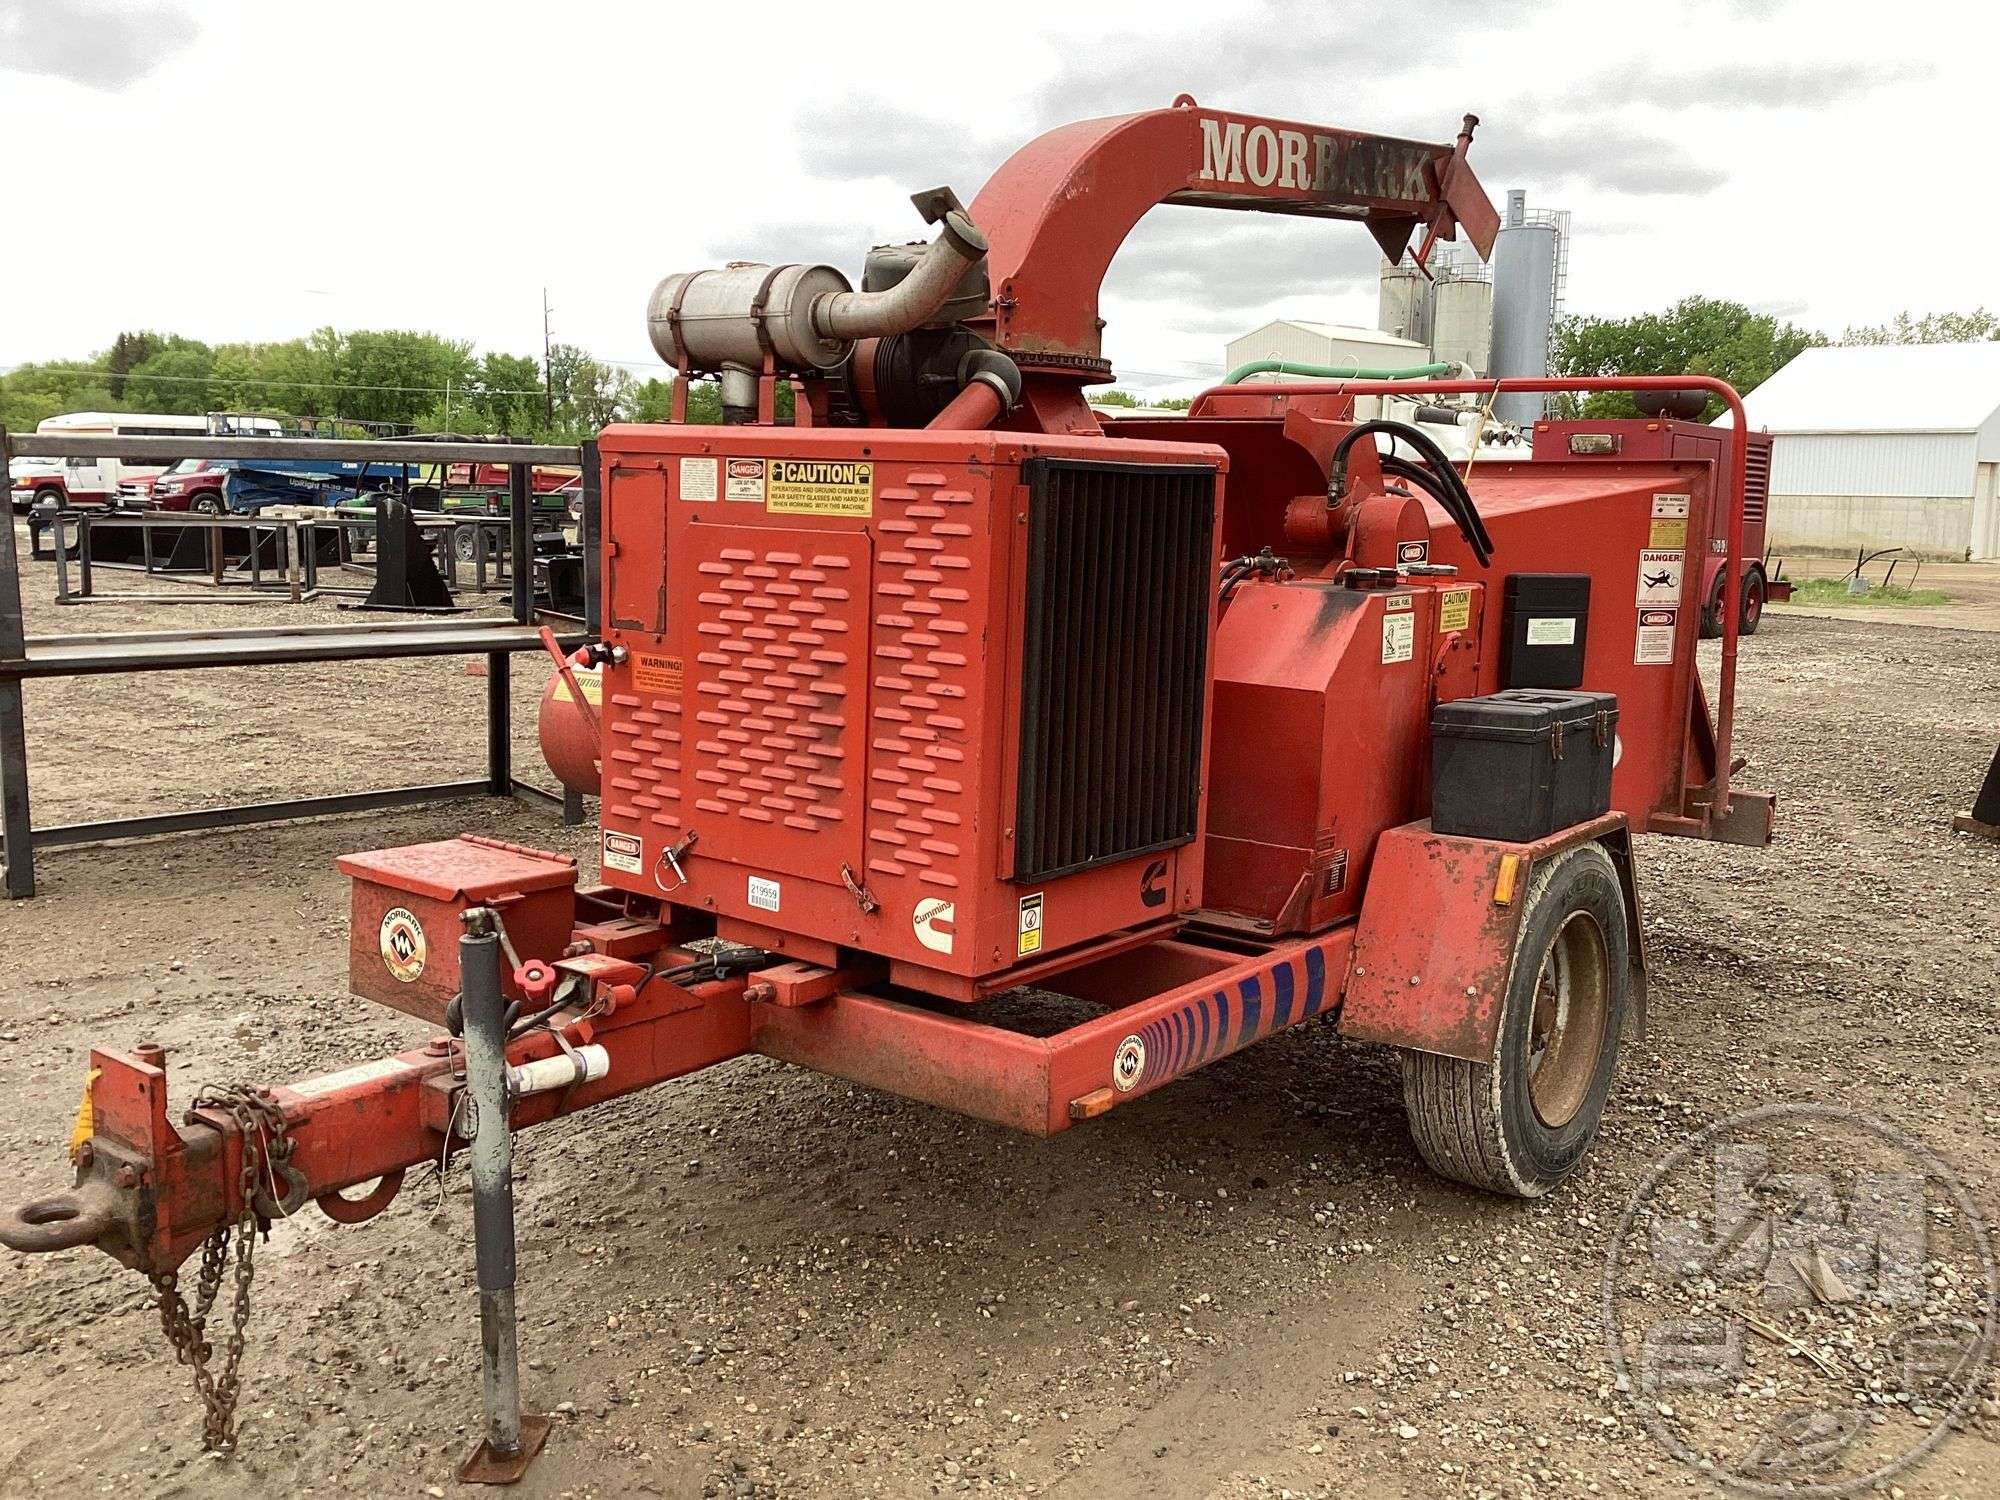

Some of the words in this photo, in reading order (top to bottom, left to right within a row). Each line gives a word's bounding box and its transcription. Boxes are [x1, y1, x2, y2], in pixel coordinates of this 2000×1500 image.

[786, 463, 854, 483] CAUTION
[1643, 553, 1682, 562] DANGER!
[640, 656, 682, 671] WARNING!
[751, 883, 777, 899] 219959
[914, 902, 952, 925] Cummins
[384, 910, 422, 936] MORBARK
